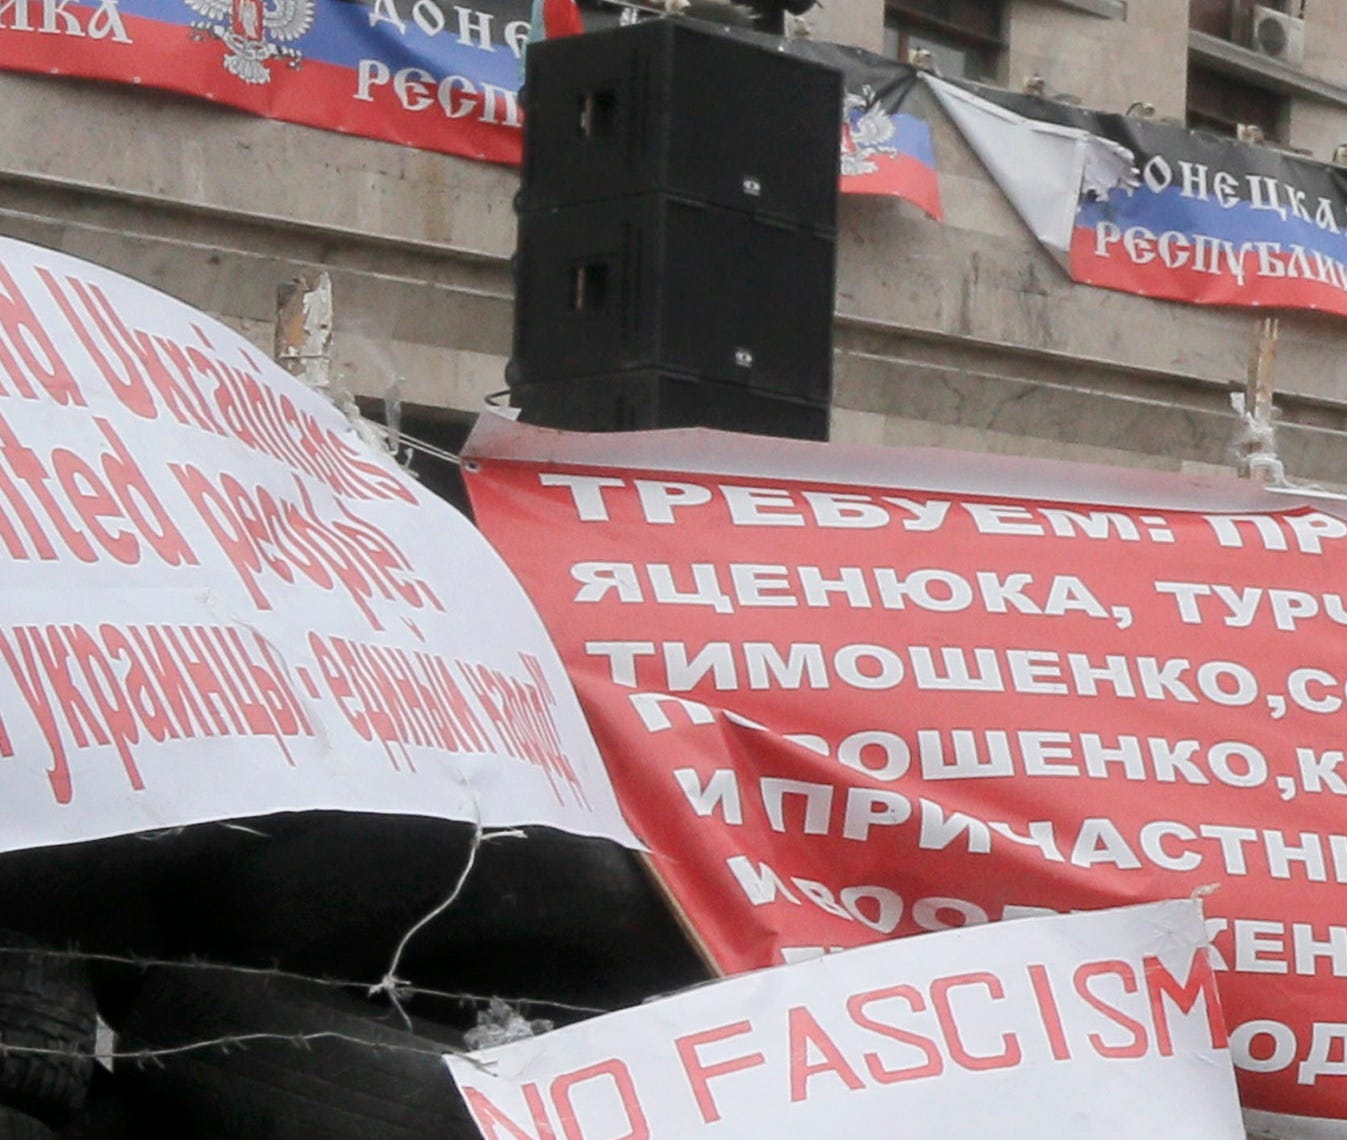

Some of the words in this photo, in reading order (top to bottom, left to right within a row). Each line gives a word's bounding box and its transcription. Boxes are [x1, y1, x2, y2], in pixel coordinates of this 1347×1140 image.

[541, 473, 1178, 544] ТРЕБУЕМ:
[166, 462, 447, 632] people!
[570, 561, 1135, 630] ЯЦЕНЮКА,
[673, 767, 743, 827] И
[674, 945, 1233, 1126] FASCISM
